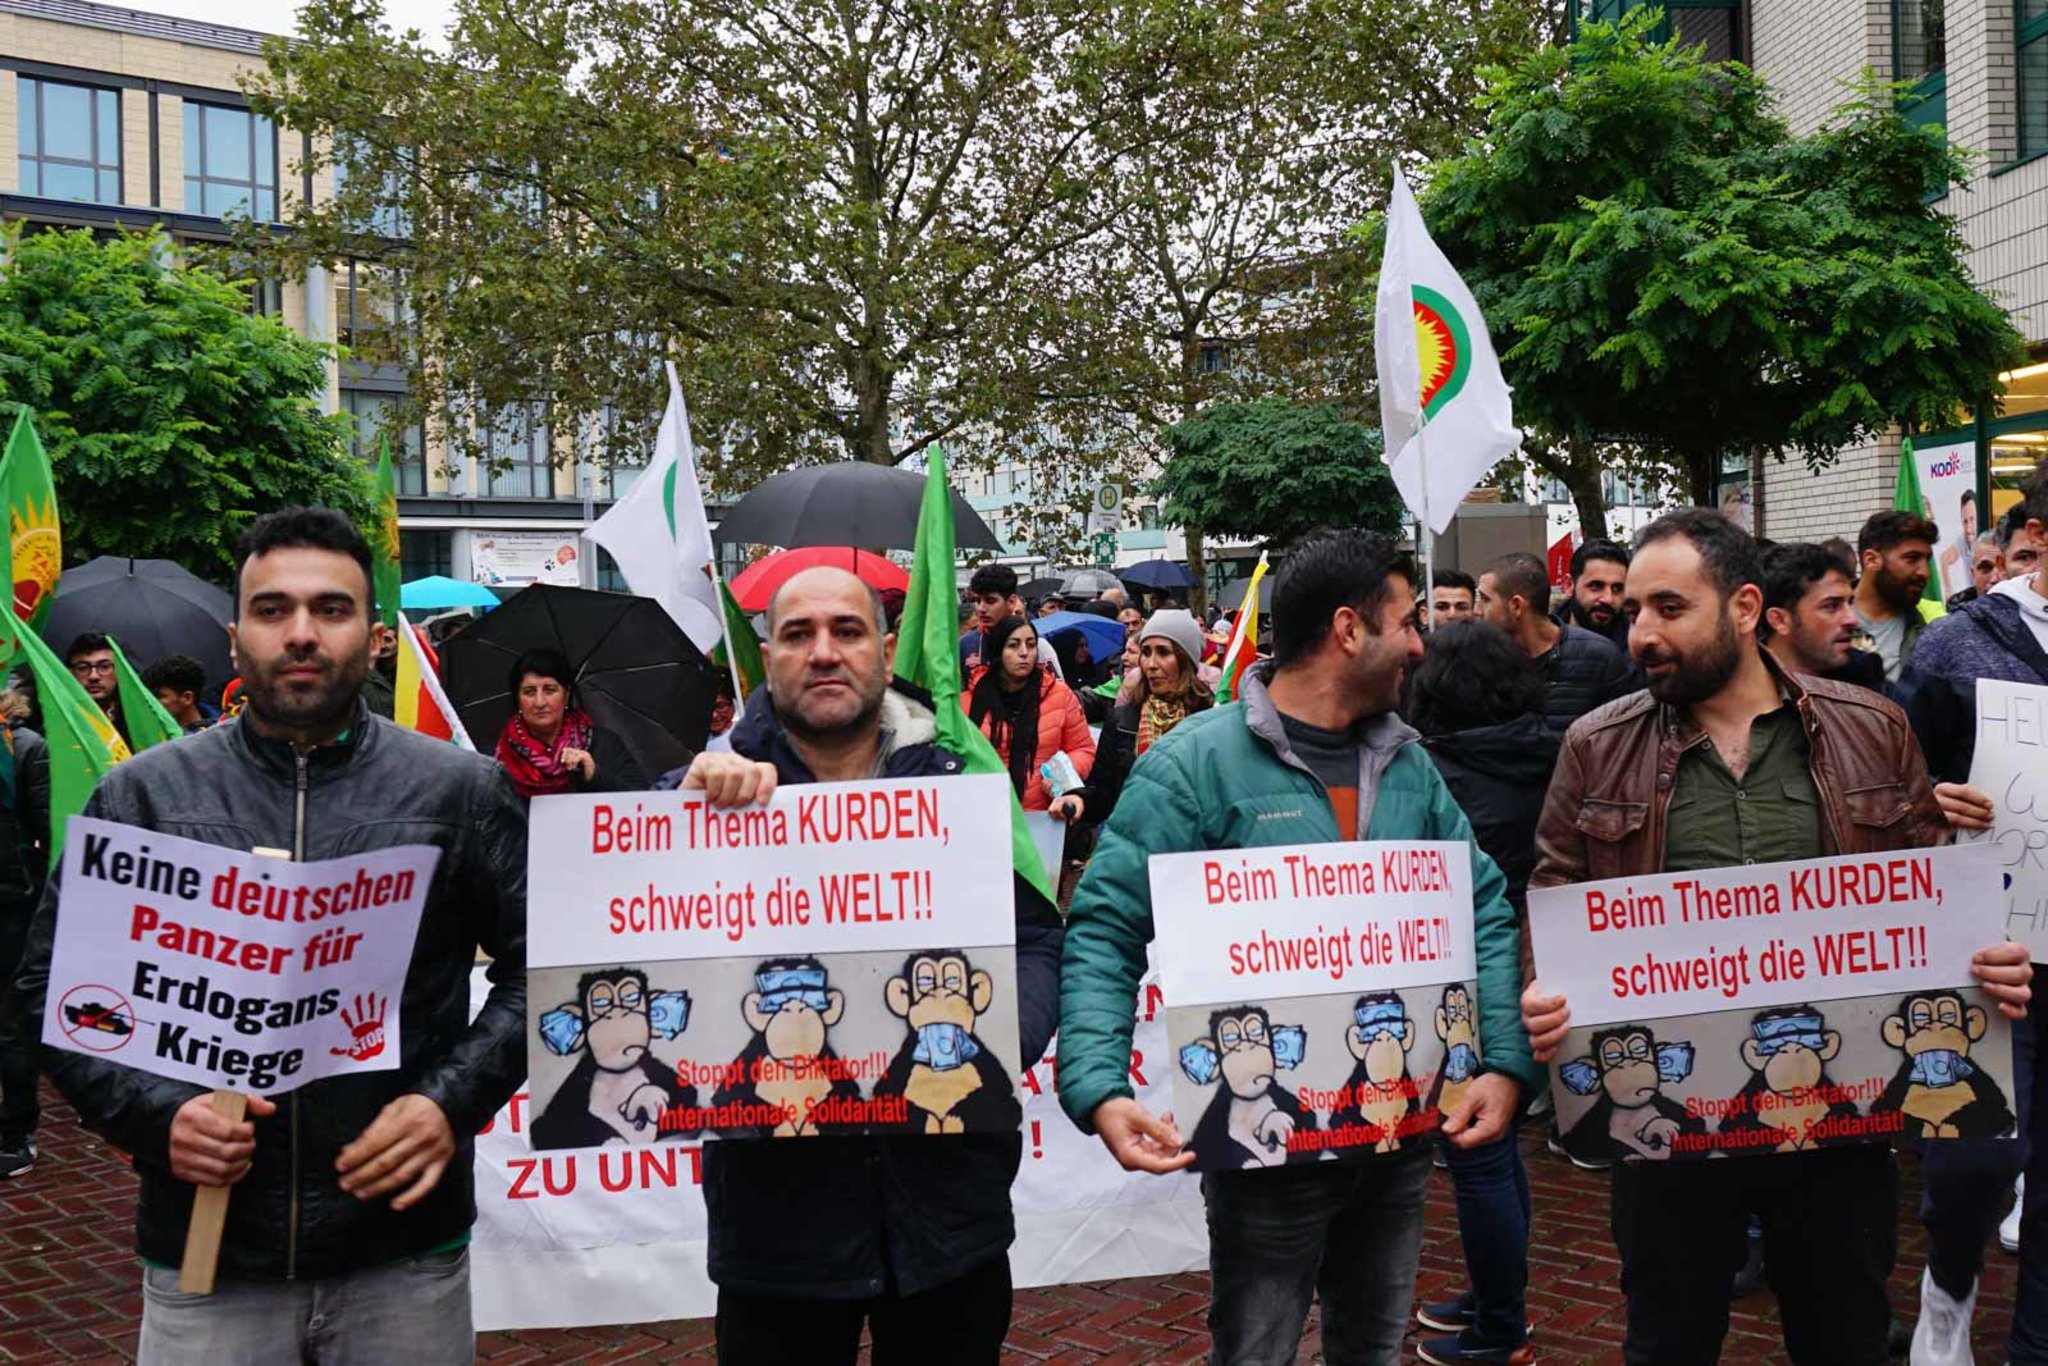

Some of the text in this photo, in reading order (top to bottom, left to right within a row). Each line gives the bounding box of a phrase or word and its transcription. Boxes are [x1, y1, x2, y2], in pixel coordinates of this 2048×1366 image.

[593, 788, 949, 853] Beim Thema KURDEN,
[82, 834, 415, 922] Keine deutschen
[609, 870, 932, 941] schweigt die WELT!!
[1204, 850, 1453, 905] Beim Thema KURDEN,
[1587, 857, 1942, 932] Beim Thema KURDEN,
[130, 904, 364, 975] Panzer für
[1229, 917, 1452, 979] schweigt die WELT!!
[1612, 926, 1928, 997] schweigt die WELT!!
[132, 961, 341, 1035] Erdogans
[155, 1022, 304, 1089] Kriege
[352, 1028, 384, 1056] STOP
[676, 1052, 889, 1091] Stoppt den Diktator!!!
[1298, 1086, 1354, 1115] Stoppt
[1355, 1080, 1382, 1105] den
[1685, 1077, 1886, 1119] Stoppt den Diktator!!!
[658, 1095, 908, 1132] Internationale Solidarität!
[1287, 1118, 1388, 1152] Internationale
[1670, 1111, 1905, 1151] Internationale Solidarität!
[507, 1156, 577, 1199] ZU
